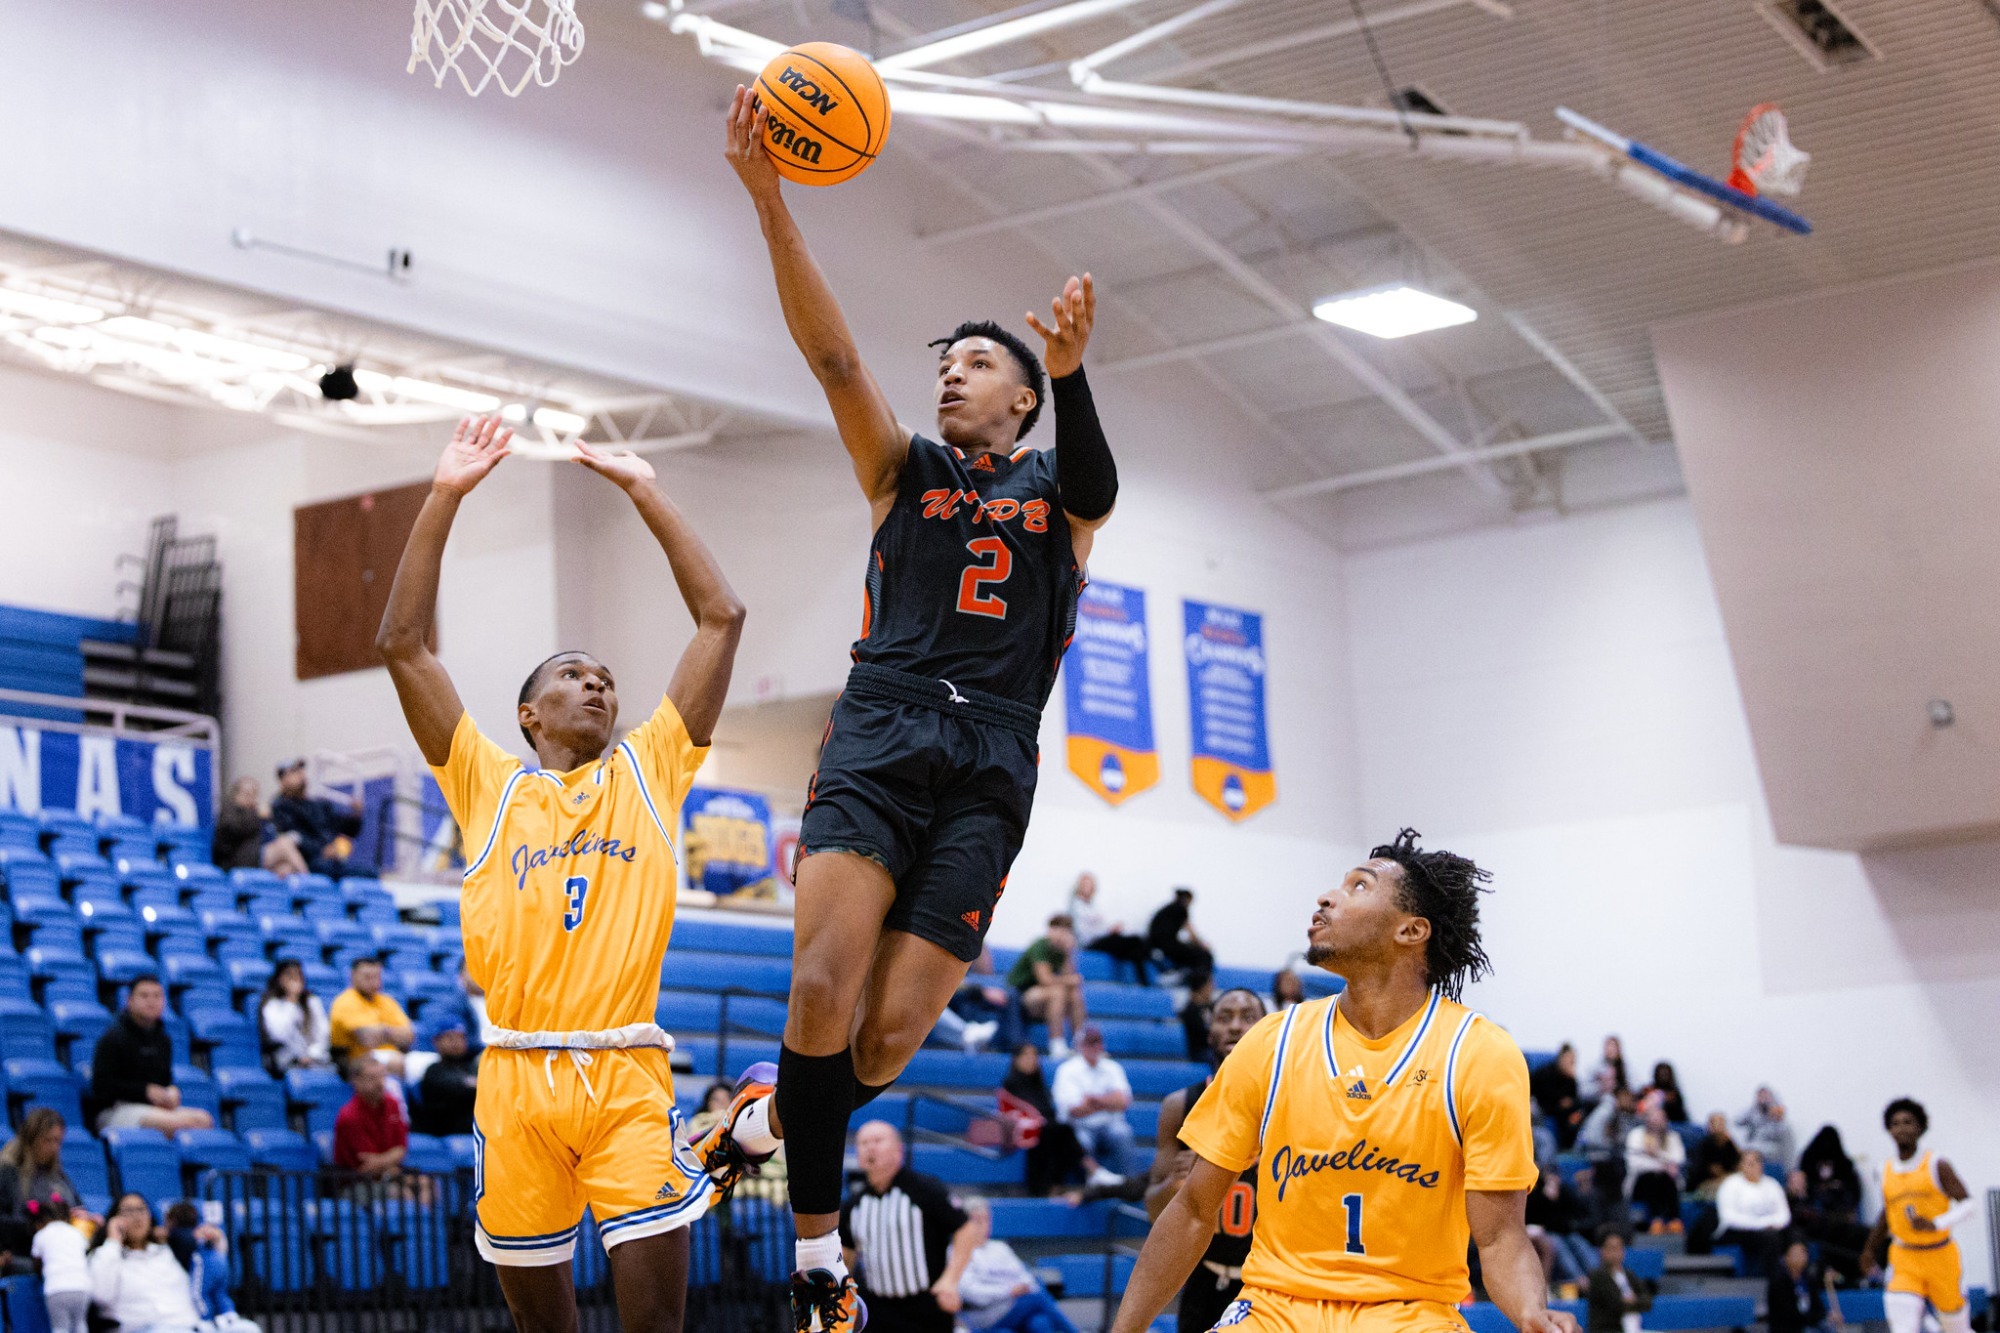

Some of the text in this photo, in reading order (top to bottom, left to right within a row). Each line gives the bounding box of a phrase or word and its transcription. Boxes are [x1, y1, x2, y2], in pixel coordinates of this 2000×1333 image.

[778, 65, 839, 116] NCAA
[920, 488, 1051, 534] UTPB
[956, 536, 1013, 620] 2
[563, 875, 589, 933] 3
[655, 1191, 681, 1201] adidas
[1272, 1139, 1440, 1203] Javelinas
[1342, 1193, 1366, 1256] 1
